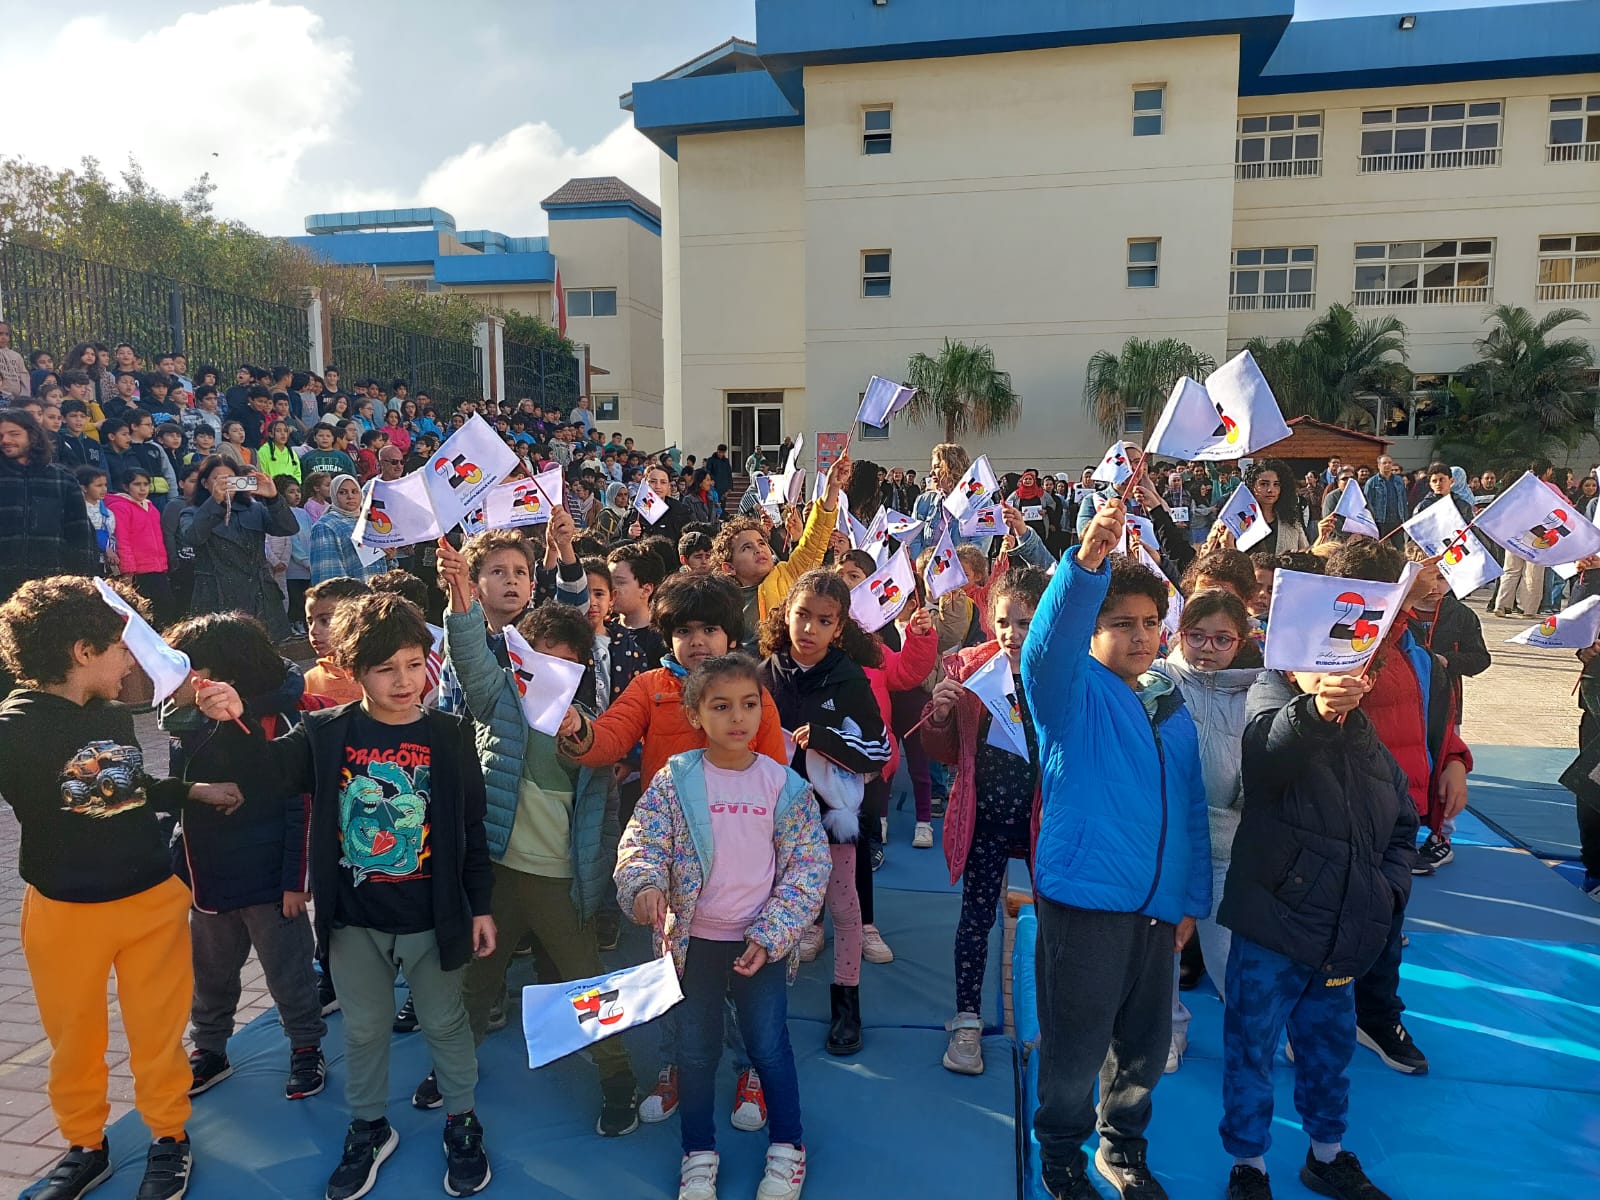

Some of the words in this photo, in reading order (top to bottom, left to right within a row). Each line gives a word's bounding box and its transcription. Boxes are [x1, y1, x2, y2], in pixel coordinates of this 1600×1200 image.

[435, 454, 483, 489] 25
[513, 485, 540, 512] 25
[1529, 509, 1571, 549] 25
[1328, 592, 1384, 652] 25
